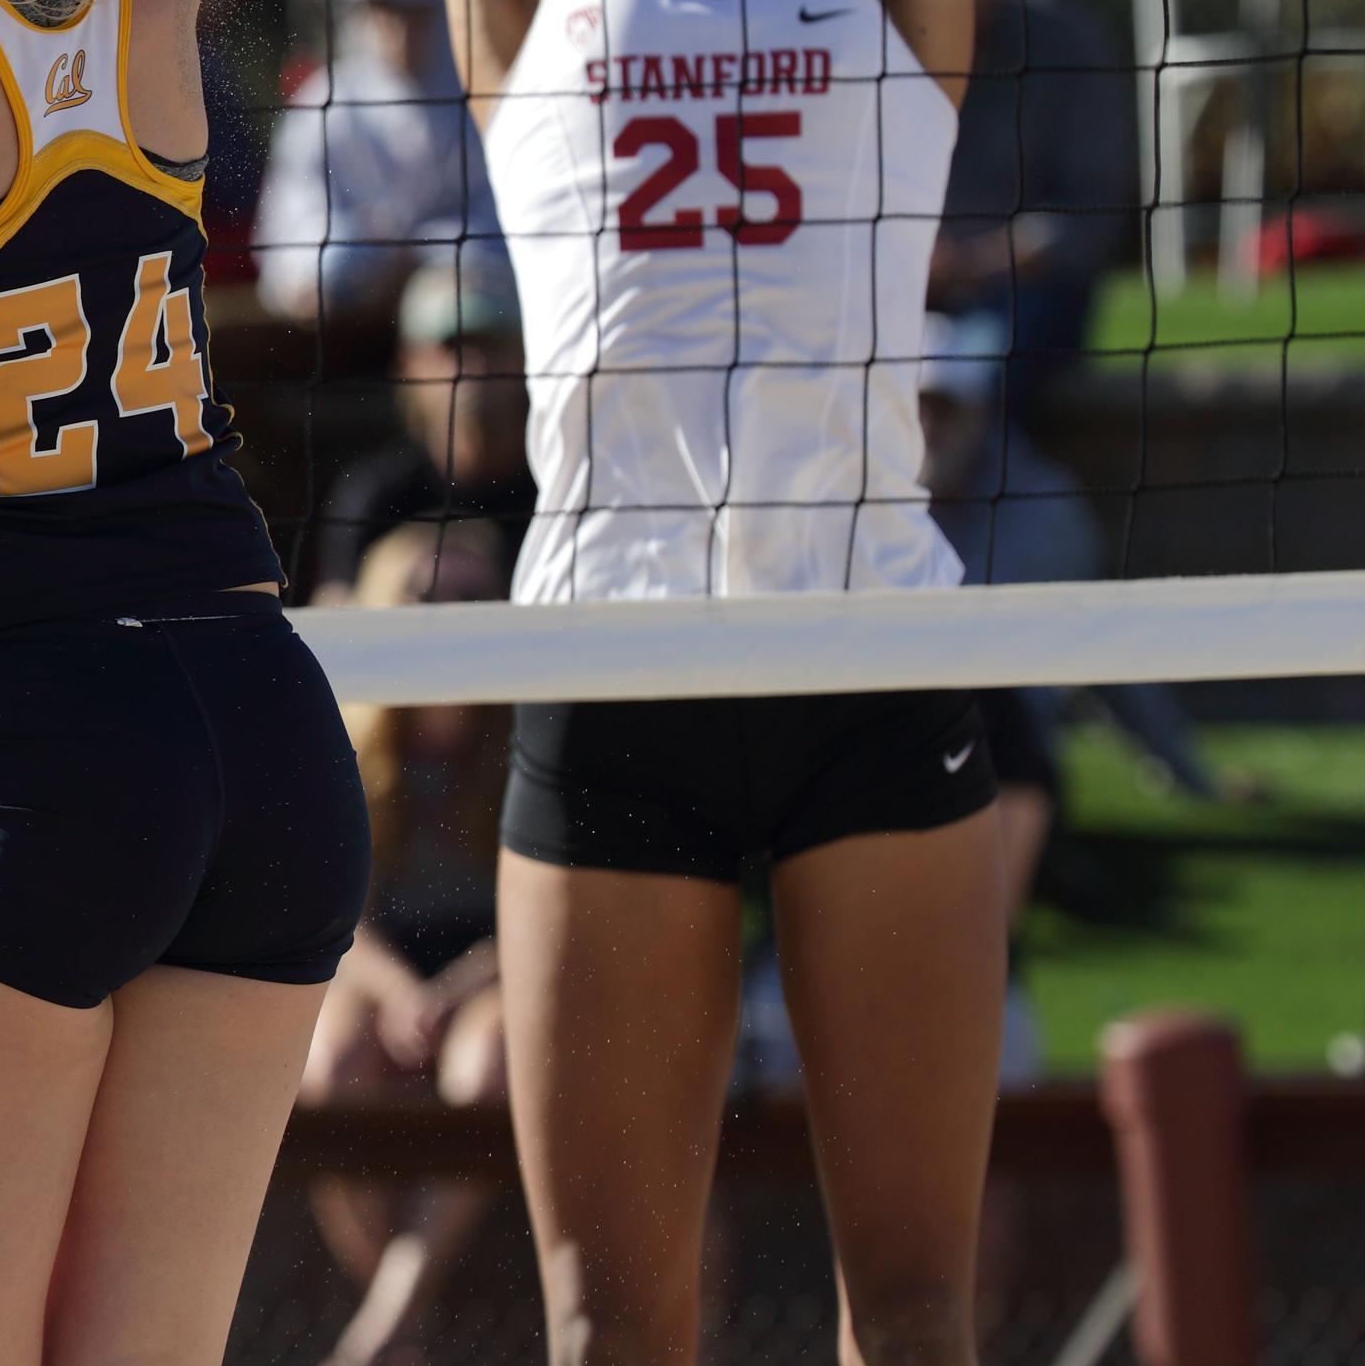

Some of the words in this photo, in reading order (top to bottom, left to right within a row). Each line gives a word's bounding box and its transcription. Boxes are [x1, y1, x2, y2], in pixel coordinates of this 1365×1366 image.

[43, 48, 93, 118] Cal
[585, 47, 832, 106] STANFORD
[612, 109, 803, 252] 25
